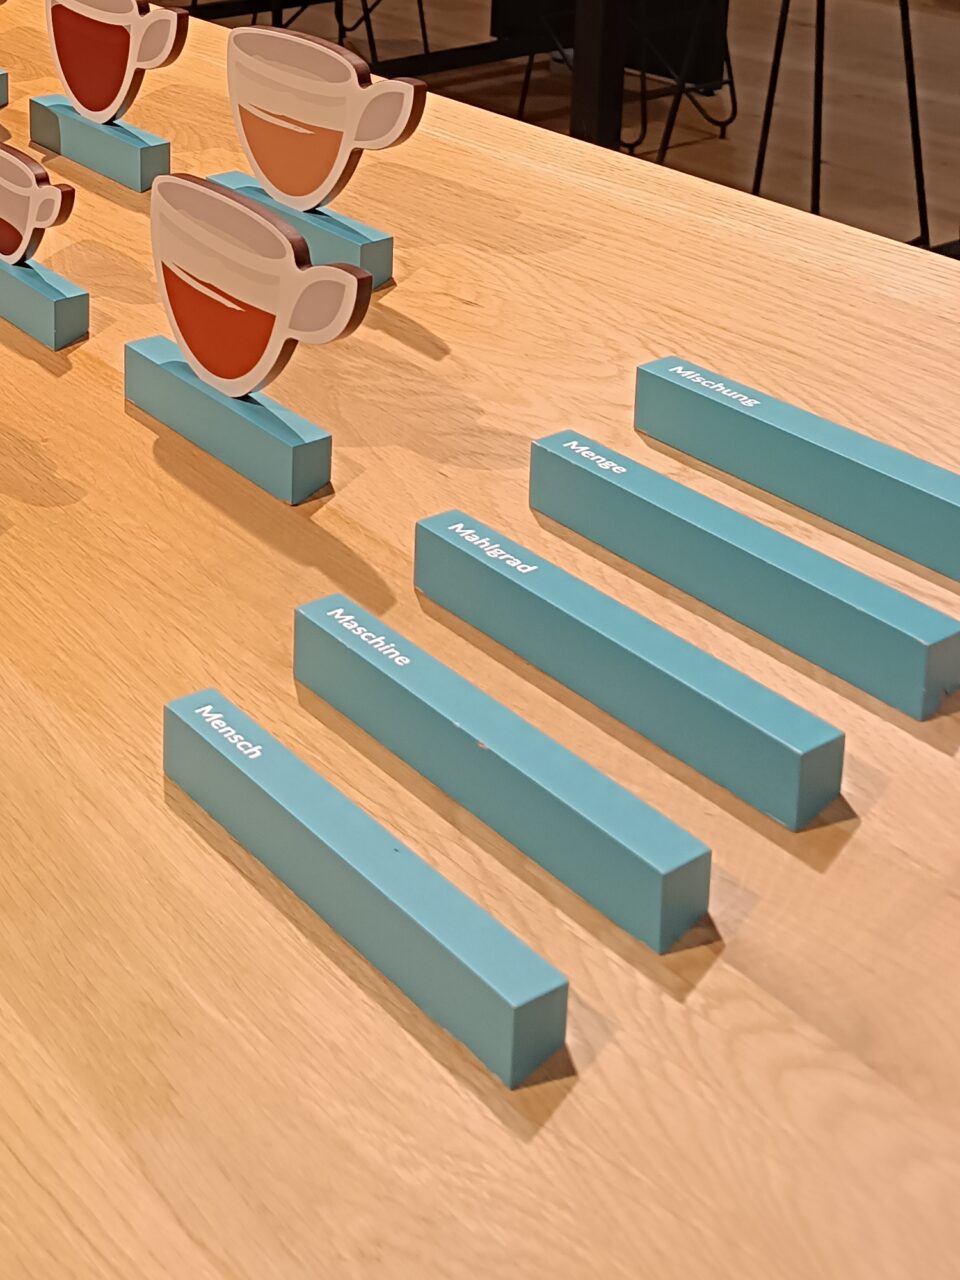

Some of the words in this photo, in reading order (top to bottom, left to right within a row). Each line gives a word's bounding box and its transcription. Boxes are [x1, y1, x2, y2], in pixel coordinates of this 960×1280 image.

[668, 365, 761, 407] Mischung
[562, 440, 627, 474] Menge
[447, 522, 539, 574] Mahlgrad
[326, 607, 411, 666] Maschine
[194, 704, 262, 759] Mensch
